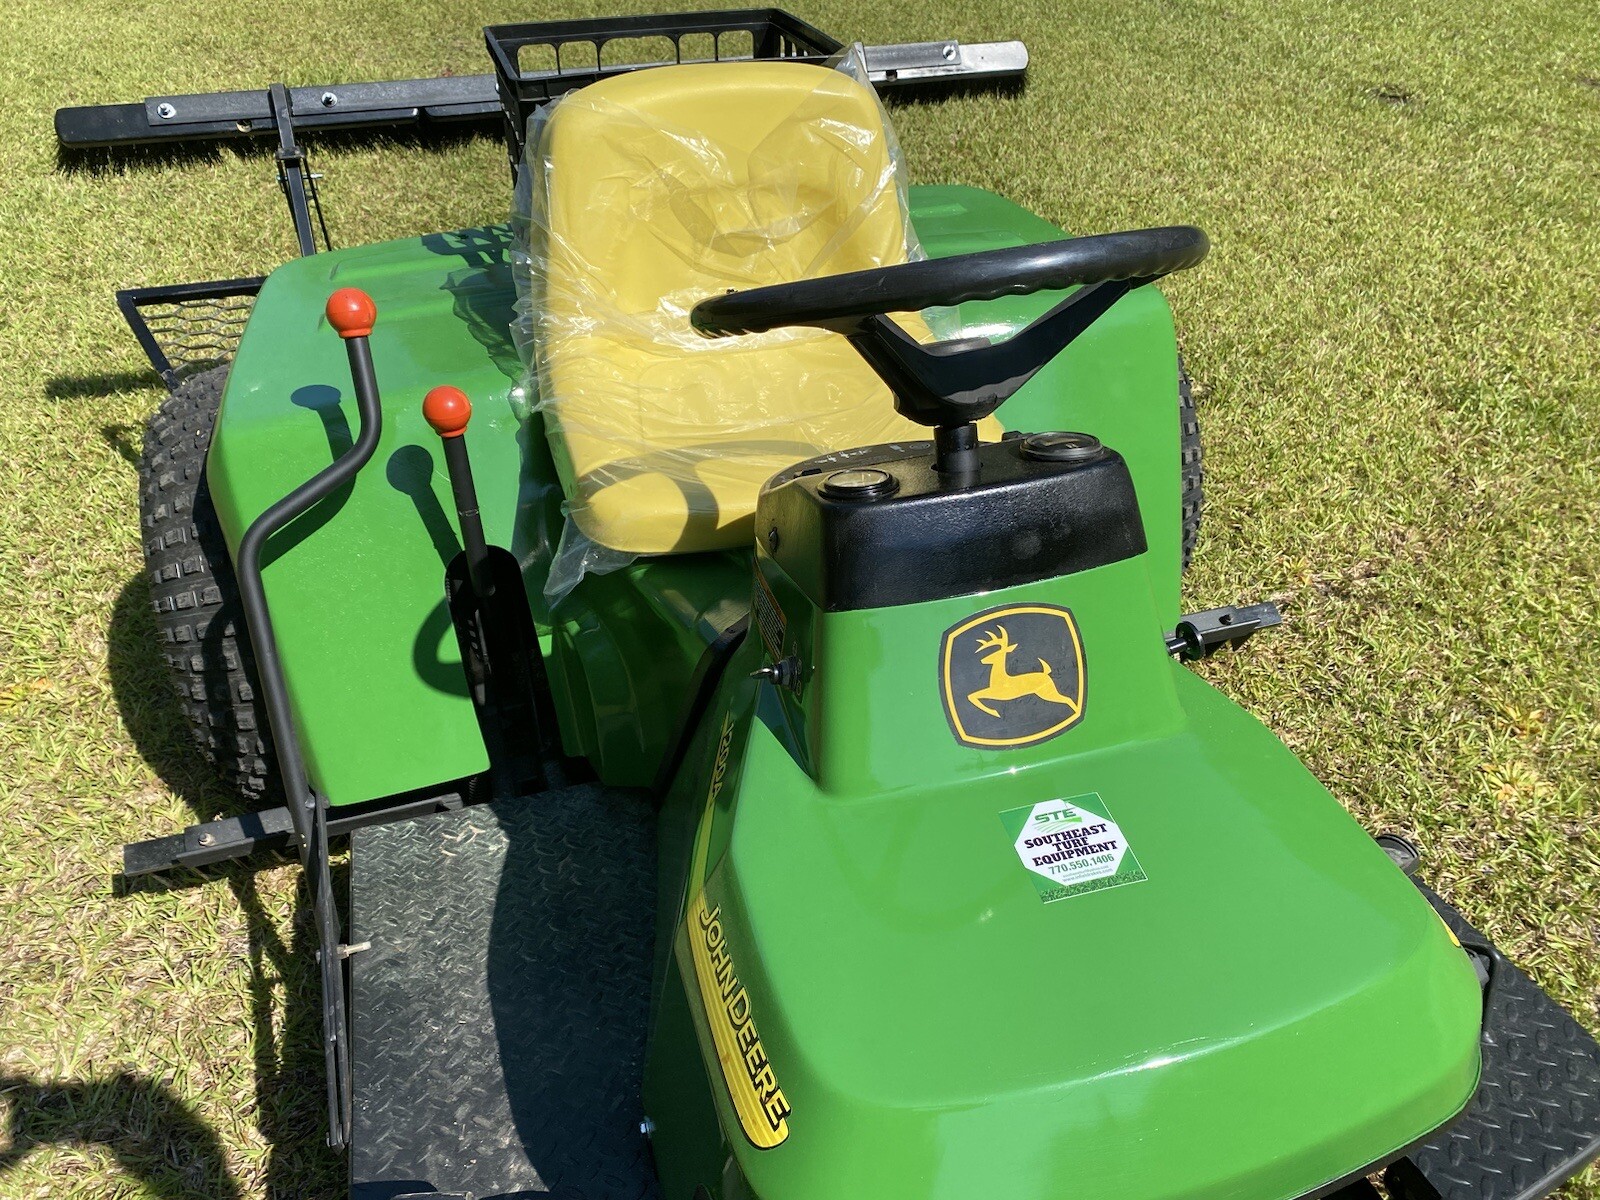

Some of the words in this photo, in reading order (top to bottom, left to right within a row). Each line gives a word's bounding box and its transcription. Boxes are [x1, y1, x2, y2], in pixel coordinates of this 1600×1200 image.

[1034, 809, 1077, 824] STE
[1024, 823, 1108, 849] SOUTHEAST
[1052, 837, 1090, 852] TURF
[1032, 840, 1118, 867] EQUIPMENT
[1048, 854, 1115, 875] 770.550.1406
[700, 903, 740, 1003] JOHN
[727, 986, 792, 1132] DEERE
